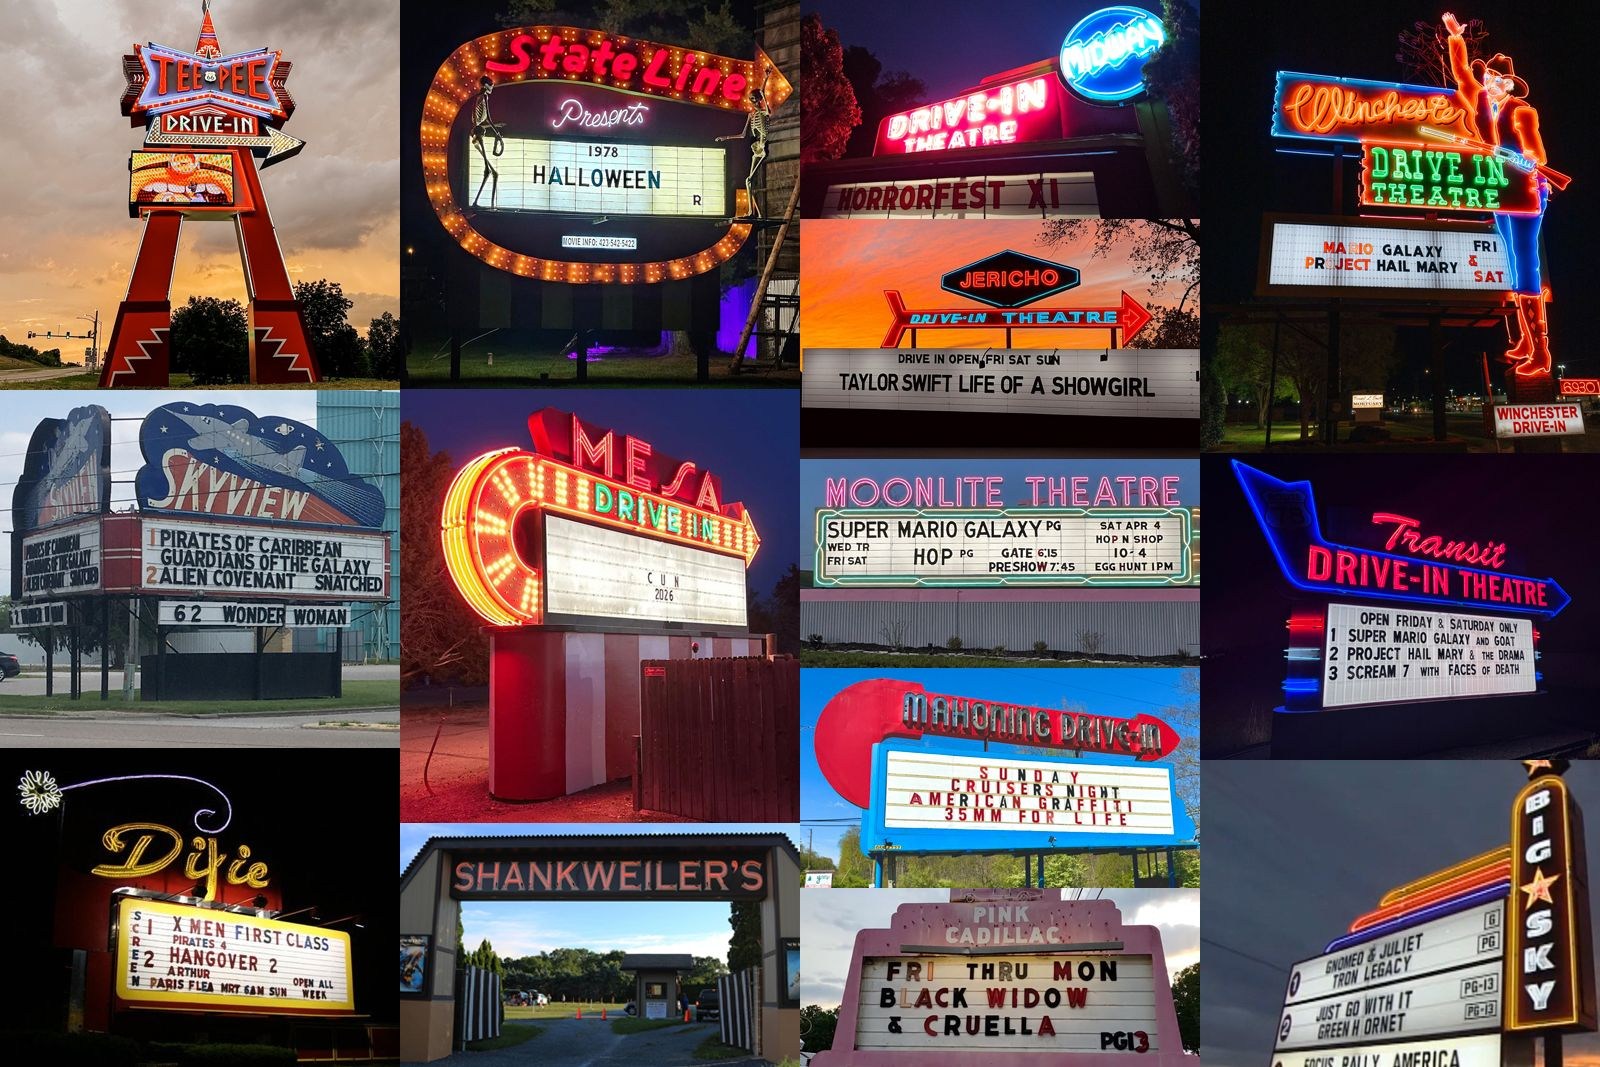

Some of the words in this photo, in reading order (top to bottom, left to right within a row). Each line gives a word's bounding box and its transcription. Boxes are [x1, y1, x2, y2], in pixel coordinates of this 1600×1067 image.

[1062, 18, 1164, 80] MIDWAY
[151, 54, 202, 95] TEE
[218, 60, 269, 100] PEE
[486, 35, 637, 79] State
[644, 50, 746, 100] Line
[552, 99, 649, 128] Presents
[887, 79, 1047, 140] DRIVE-IN
[1285, 84, 1475, 136] Winchester
[167, 115, 254, 134] DRIVE-IN
[903, 120, 1018, 153] THEATRE
[588, 146, 618, 158] 1978
[1371, 147, 1462, 182] DRIVE
[1474, 154, 1509, 187] IN
[533, 165, 661, 190] HALLOWEEN
[693, 194, 702, 206] R
[837, 180, 1005, 211] HORRORFEST
[1027, 178, 1060, 209] XI
[1372, 183, 1500, 209] THEATRE
[563, 237, 581, 246] MOVIE
[582, 238, 598, 246] INFO:
[599, 239, 635, 248] 423-542-5422
[1323, 241, 1374, 256] MARIO
[1382, 244, 1443, 258] GALAXY
[1474, 240, 1497, 252] FRI
[1305, 256, 1371, 271] PROJECT
[1377, 260, 1410, 272] HAIL
[1416, 261, 1458, 274] MARY
[960, 270, 1059, 288] JERICHO
[1474, 271, 1504, 283] SAT
[910, 312, 987, 324] DRIVE-IN
[1002, 311, 1118, 324] THEATRE
[898, 354, 930, 364] DRIVE
[949, 354, 980, 364] OPEN
[986, 355, 1004, 364] FRI
[1009, 355, 1031, 365] SAT
[1036, 355, 1060, 366] SUN
[840, 373, 898, 392] TAYLOR
[902, 374, 952, 392] SWIFT
[958, 375, 995, 394] LIFE
[1052, 376, 1155, 398] SHOWGIRL
[1564, 382, 1596, 393] 6930
[1497, 406, 1578, 420] WINCHESTER
[1513, 420, 1567, 434] DRIVE-IN
[572, 412, 720, 512] MESA
[147, 448, 309, 521] SKYVIEW
[826, 477, 1004, 508] MOONLITE
[1025, 476, 1180, 506] THEATRE
[594, 483, 680, 533] DRIVE
[692, 514, 713, 541] IN
[828, 521, 888, 539] SUPER
[898, 521, 958, 539] MARIO
[964, 520, 1043, 538] GALAXY
[1046, 521, 1061, 532] PG
[1100, 521, 1122, 530] SAT
[1126, 521, 1148, 530] APR
[160, 529, 232, 552] PIRATES
[259, 536, 342, 558] CARIBBEAN
[828, 543, 852, 552] WED
[1096, 535, 1118, 544] HOP
[1134, 535, 1164, 544] SHOP
[1372, 512, 1506, 568] Transit
[160, 549, 254, 570] GUARDIANS
[260, 555, 276, 571] OF
[280, 556, 308, 573] THE
[312, 558, 371, 576] GALAXY
[828, 556, 845, 566] FRI
[848, 556, 868, 566] SAT
[914, 548, 952, 566] HOP
[1002, 548, 1032, 558] GATE
[989, 561, 1047, 573] PRESHOW
[1095, 562, 1116, 572] EGG
[1119, 562, 1148, 572] HUNT
[1151, 562, 1174, 572] 1PM
[1308, 544, 1450, 596] DRIVE-IN
[1459, 570, 1548, 608] THEATRE
[160, 567, 208, 586] ALIEN
[213, 570, 296, 590] COVENANT
[314, 574, 383, 592] SNATCHED
[655, 588, 674, 602] 2026
[223, 606, 286, 624] WONDER
[294, 608, 347, 626] WOMAN
[1360, 612, 1390, 626] OPEN
[1396, 614, 1432, 628] FRIDAY
[1450, 618, 1494, 632] SATURDAY
[1500, 622, 1518, 634] ONLY
[1348, 629, 1386, 643] SUPER
[1394, 631, 1427, 644] MARIO
[1434, 632, 1470, 645] GALAXY
[1476, 637, 1490, 646] AND
[1494, 636, 1515, 646] GOAT
[1348, 648, 1400, 660] PROJECT
[1408, 648, 1431, 660] HAIL
[1438, 648, 1464, 660] MARY
[1499, 650, 1524, 660] DRAMA
[1348, 665, 1396, 680] SCREAM
[1420, 667, 1440, 677] WITH
[1449, 664, 1476, 676] FACES
[1496, 664, 1520, 674] DEATH
[903, 691, 1050, 737] MAHONING
[1061, 712, 1162, 750] DRIVE-IN
[980, 766, 1079, 785] SUNDAY
[952, 778, 1053, 797] CRUISERS
[1066, 784, 1120, 799] NIGHT
[910, 792, 1022, 810] AMERICAN
[1038, 796, 1132, 813] GRAFFITI
[945, 808, 1002, 823] 35MM
[1019, 811, 1054, 824] FOR
[1075, 812, 1127, 826] LIFE
[1525, 789, 1552, 864] BIG
[91, 822, 270, 902] Dixie
[454, 860, 764, 892] SHANKWEILER'S
[973, 906, 1031, 924] PINK
[172, 934, 214, 948] PIRATES
[190, 918, 225, 938] MEN
[235, 925, 282, 945] FIRST
[286, 932, 329, 952] CLASS
[946, 926, 1060, 944] CADILLAC
[1481, 936, 1496, 949] PG
[170, 946, 258, 972] HANGOVER
[1326, 952, 1364, 974] GNOMEO
[1379, 933, 1424, 960] JULIET
[1524, 910, 1556, 1011] SKY
[167, 966, 210, 979] ARTHUR
[886, 961, 934, 982] FRI
[966, 962, 1028, 982] THRU
[1053, 960, 1118, 982] MON
[1332, 970, 1358, 989] TRON
[1364, 956, 1412, 982] LEGACY
[150, 977, 184, 990] PARIS
[188, 980, 214, 992] FLEA
[221, 983, 240, 994] MRT
[244, 985, 264, 996] 6AM
[269, 986, 287, 997] SUN
[293, 978, 314, 988] OPEN
[319, 979, 334, 990] ALL
[1464, 978, 1494, 994] PG-13
[302, 990, 327, 1000] WEEK
[880, 987, 968, 1008] BLACK
[986, 987, 1088, 1008] WIDOW
[1316, 1003, 1342, 1022] JUST
[1364, 994, 1393, 1016] WITH
[1467, 1005, 1495, 1016] PG-13
[924, 1015, 1056, 1037] CRUELLA
[1100, 1030, 1150, 1054] PG13
[1392, 1050, 1460, 1067] AMERICA
